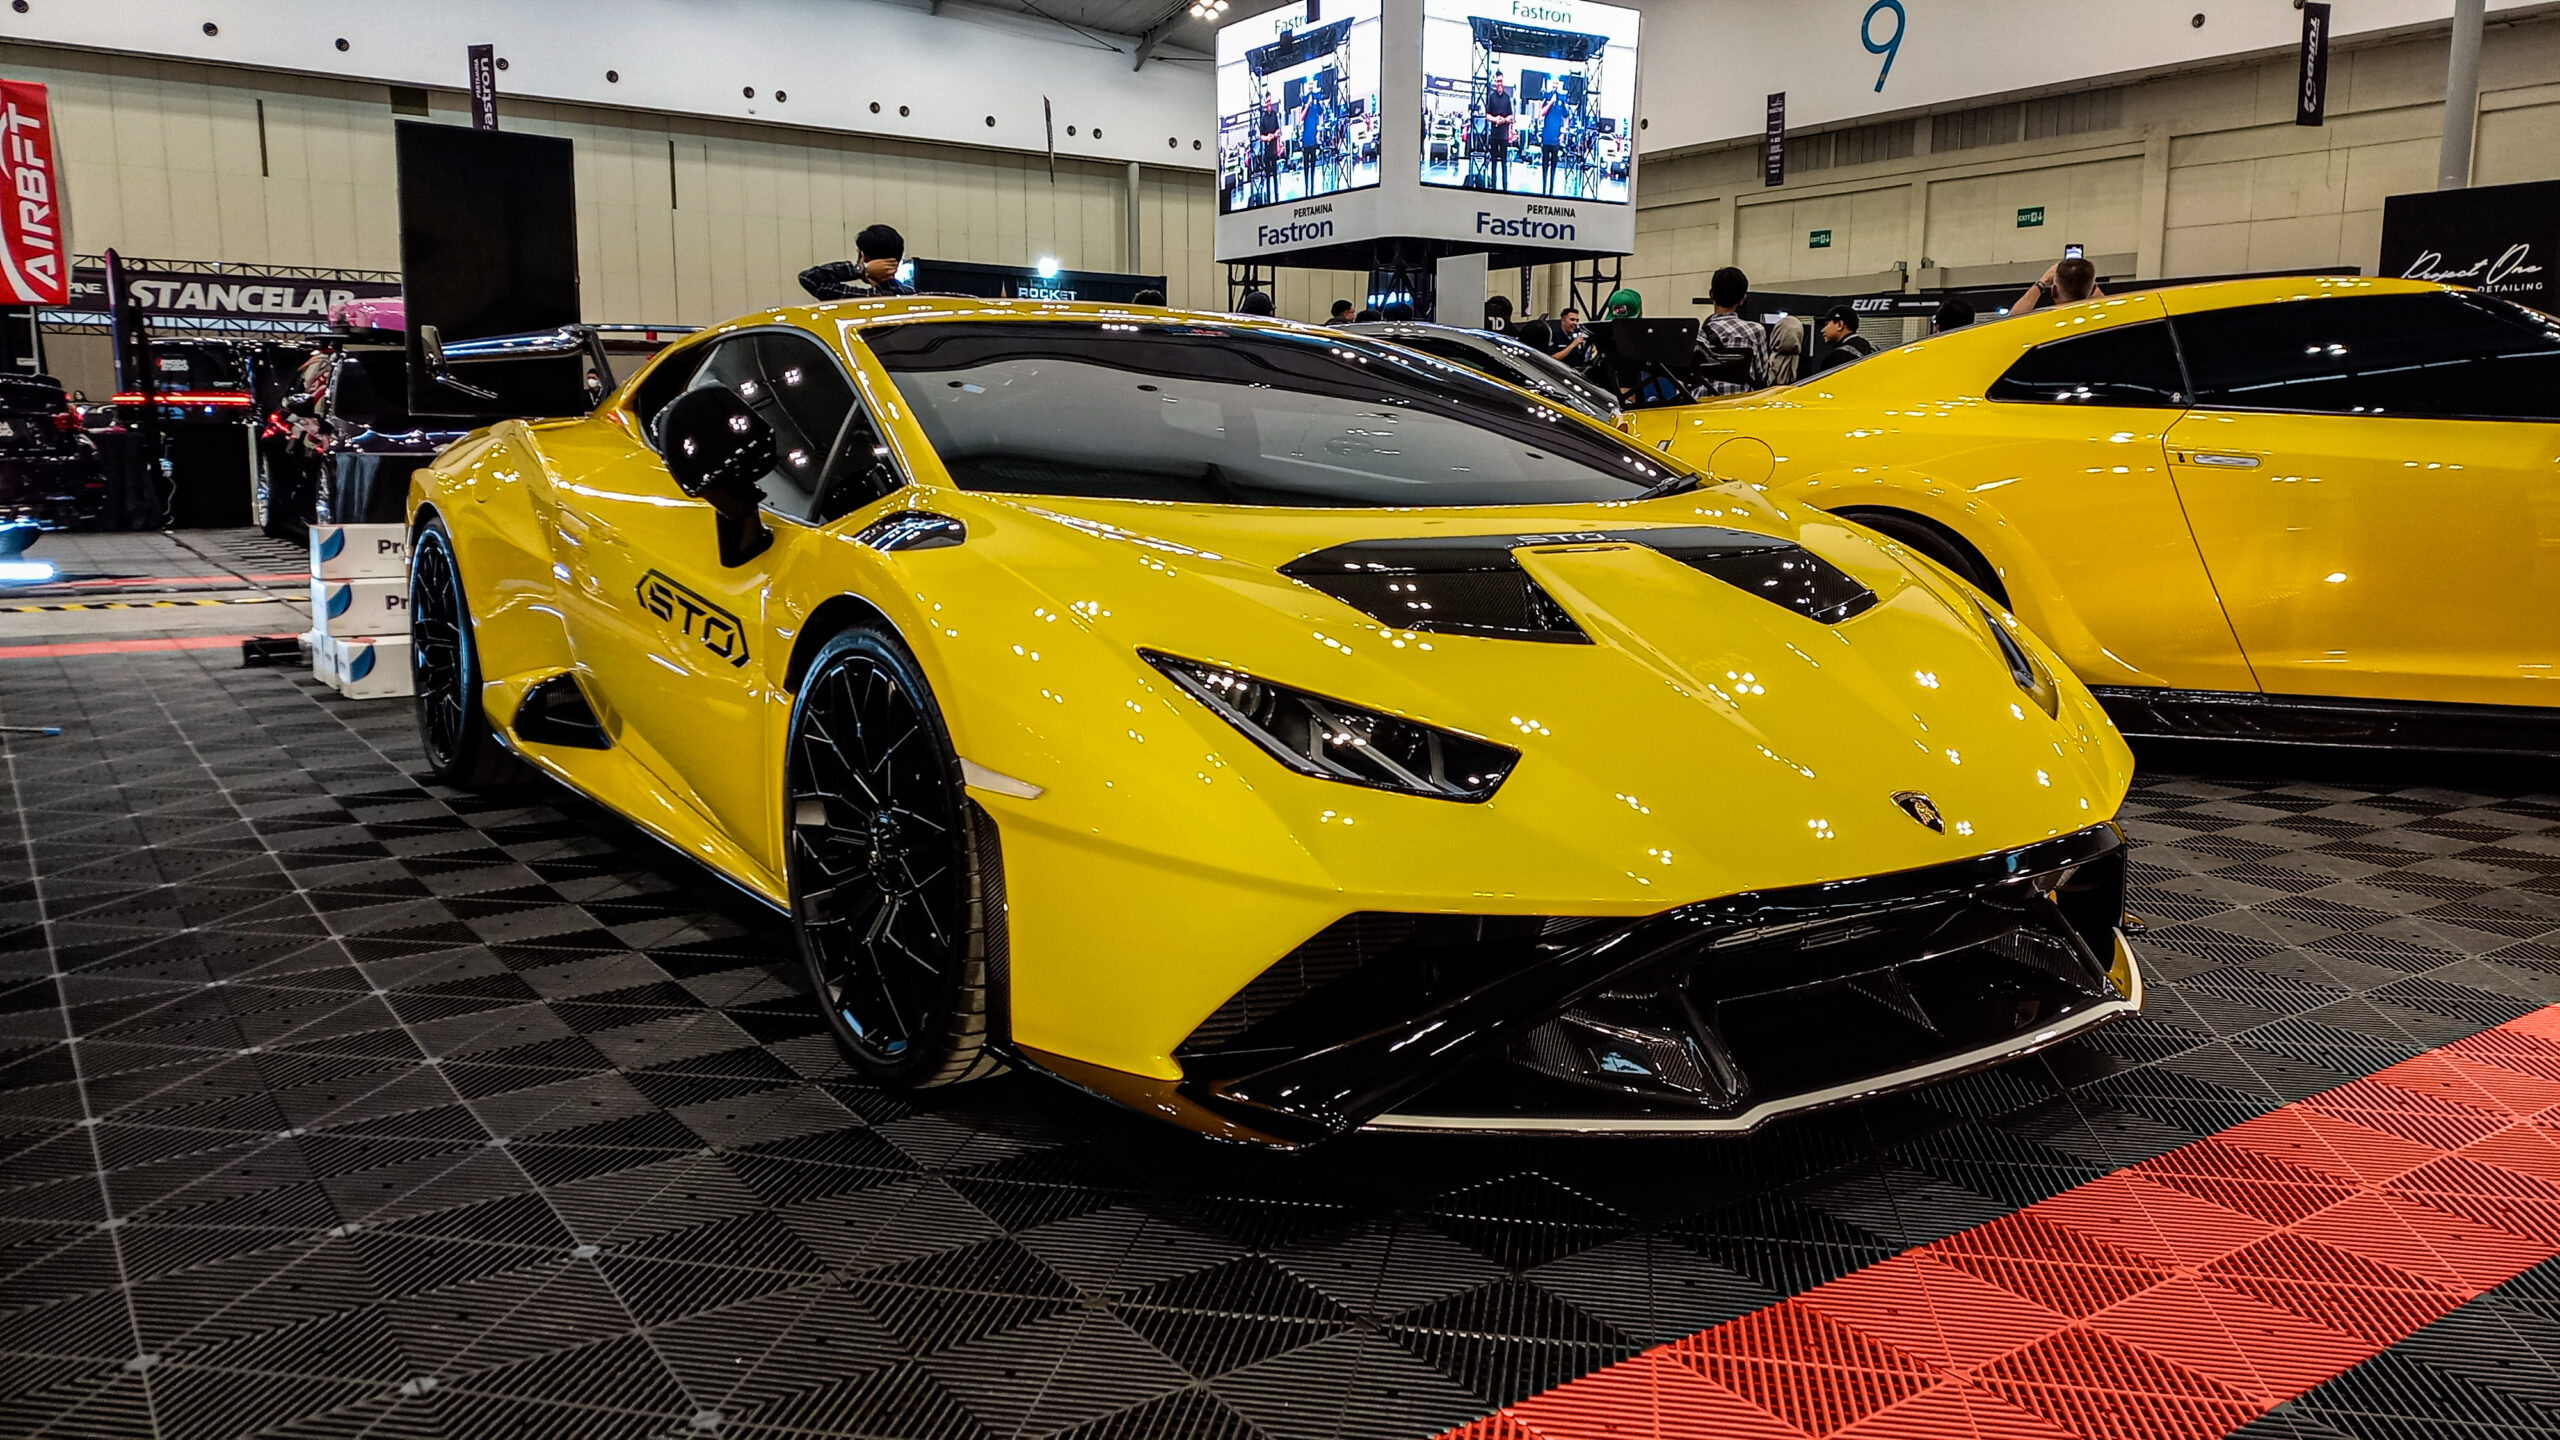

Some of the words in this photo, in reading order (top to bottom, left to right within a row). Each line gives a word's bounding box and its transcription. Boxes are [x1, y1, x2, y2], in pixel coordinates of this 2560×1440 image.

[1512, 0, 1571, 23] Fastron
[1861, 0, 1907, 93] 9
[7, 102, 59, 291] AIRBFT
[1293, 203, 1333, 218] PERTAMINA
[1526, 204, 1577, 218] PERTAMINA
[1258, 219, 1333, 247] Fastron
[1475, 211, 1577, 242] Fastron
[2401, 249, 2489, 282] Project
[2486, 243, 2543, 285] One
[1018, 287, 1077, 301] ROCKET
[2477, 282, 2543, 293] DETAILING
[1851, 298, 1893, 311] ELITE
[378, 539, 405, 554] Pr
[1516, 532, 1606, 543] STO
[647, 582, 735, 659] STO
